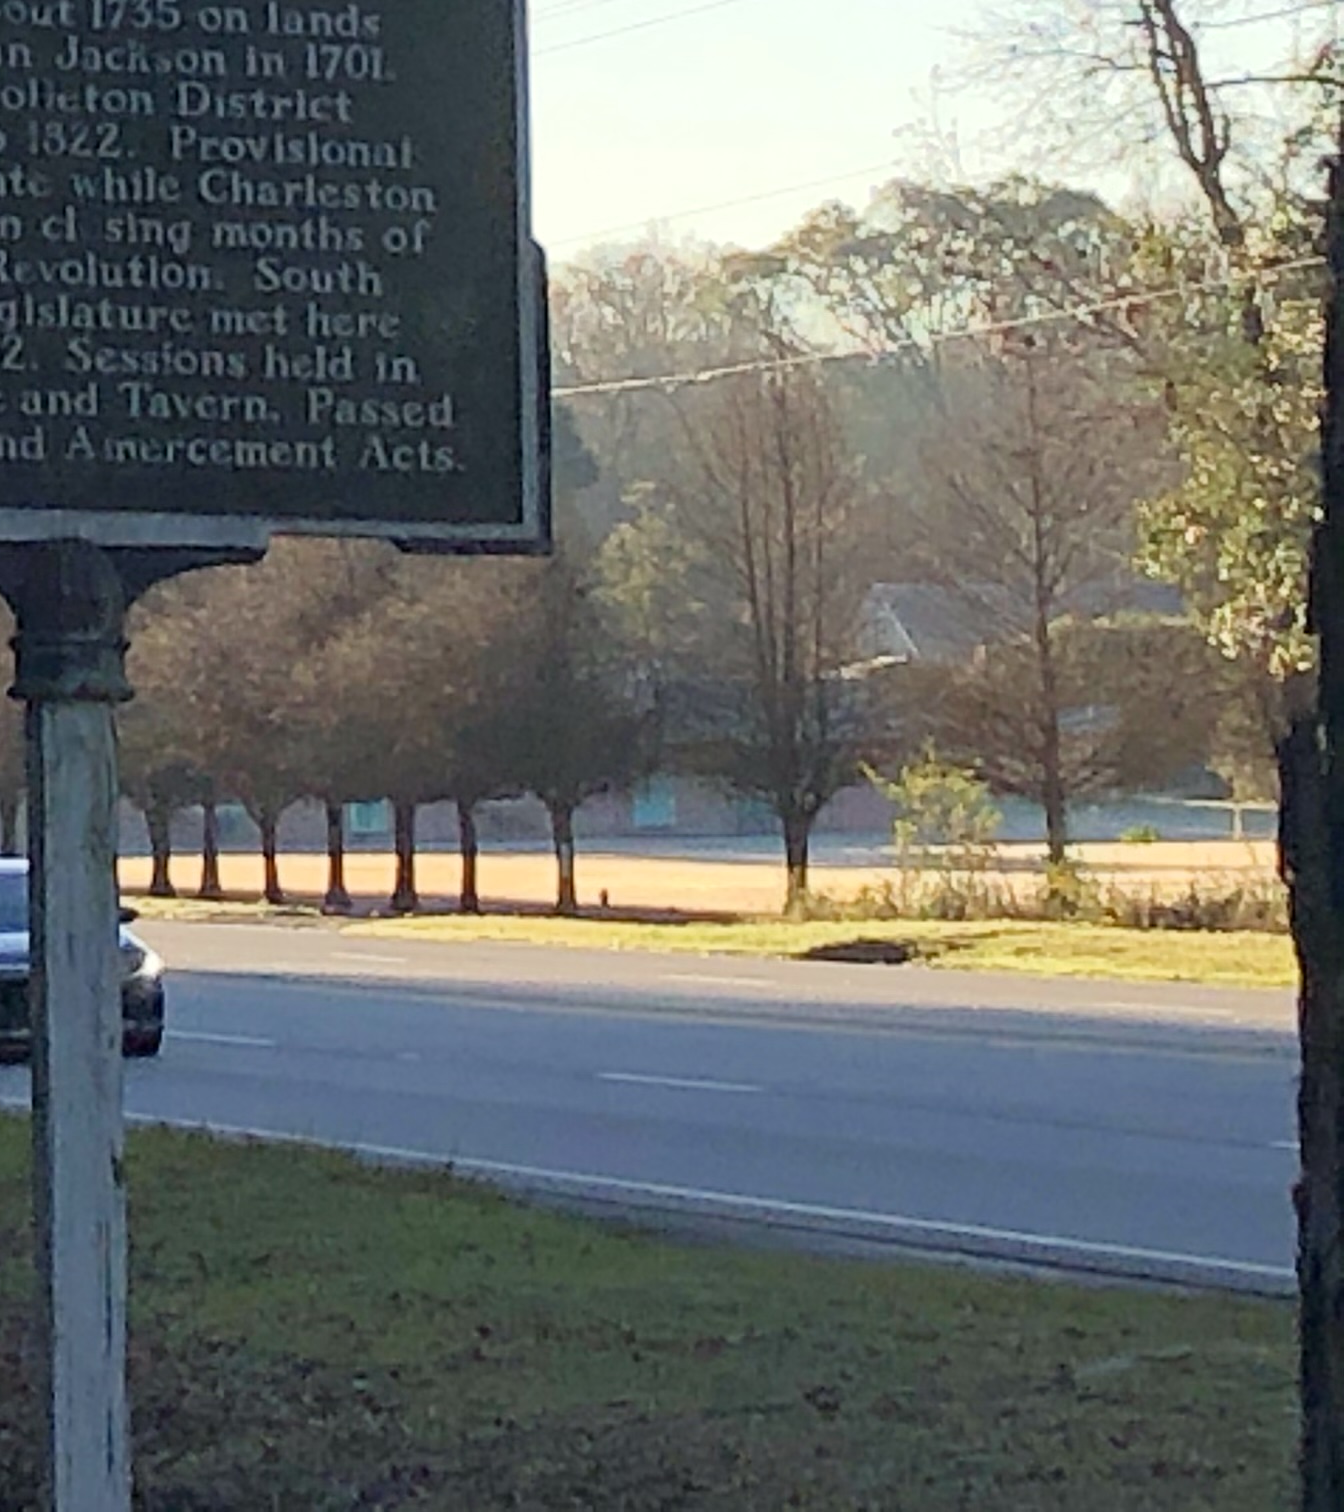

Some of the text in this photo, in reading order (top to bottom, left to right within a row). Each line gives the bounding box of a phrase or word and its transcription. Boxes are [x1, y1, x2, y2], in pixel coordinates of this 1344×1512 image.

[198, 7, 249, 34] on
[267, 1, 382, 37] lands
[55, 35, 226, 76] Jackson
[246, 45, 285, 78] in
[307, 44, 396, 81] 1701.
[177, 82, 354, 124] District
[28, 120, 135, 159] 1822.
[171, 125, 412, 170] Provisional
[71, 167, 180, 203] while
[198, 169, 437, 213] Charleston
[42, 205, 192, 253] clsing
[213, 215, 364, 251] months
[381, 221, 431, 254] of
[253, 257, 383, 297] South
[211, 303, 288, 336] met
[306, 302, 401, 339] here
[64, 335, 246, 378] Sessions
[263, 344, 354, 382] held
[375, 353, 418, 383] in
[19, 383, 99, 417] and
[117, 381, 280, 422] Tavern.
[306, 387, 455, 428] Passed
[64, 425, 337, 468] Amercement
[359, 434, 467, 472] Acts.
